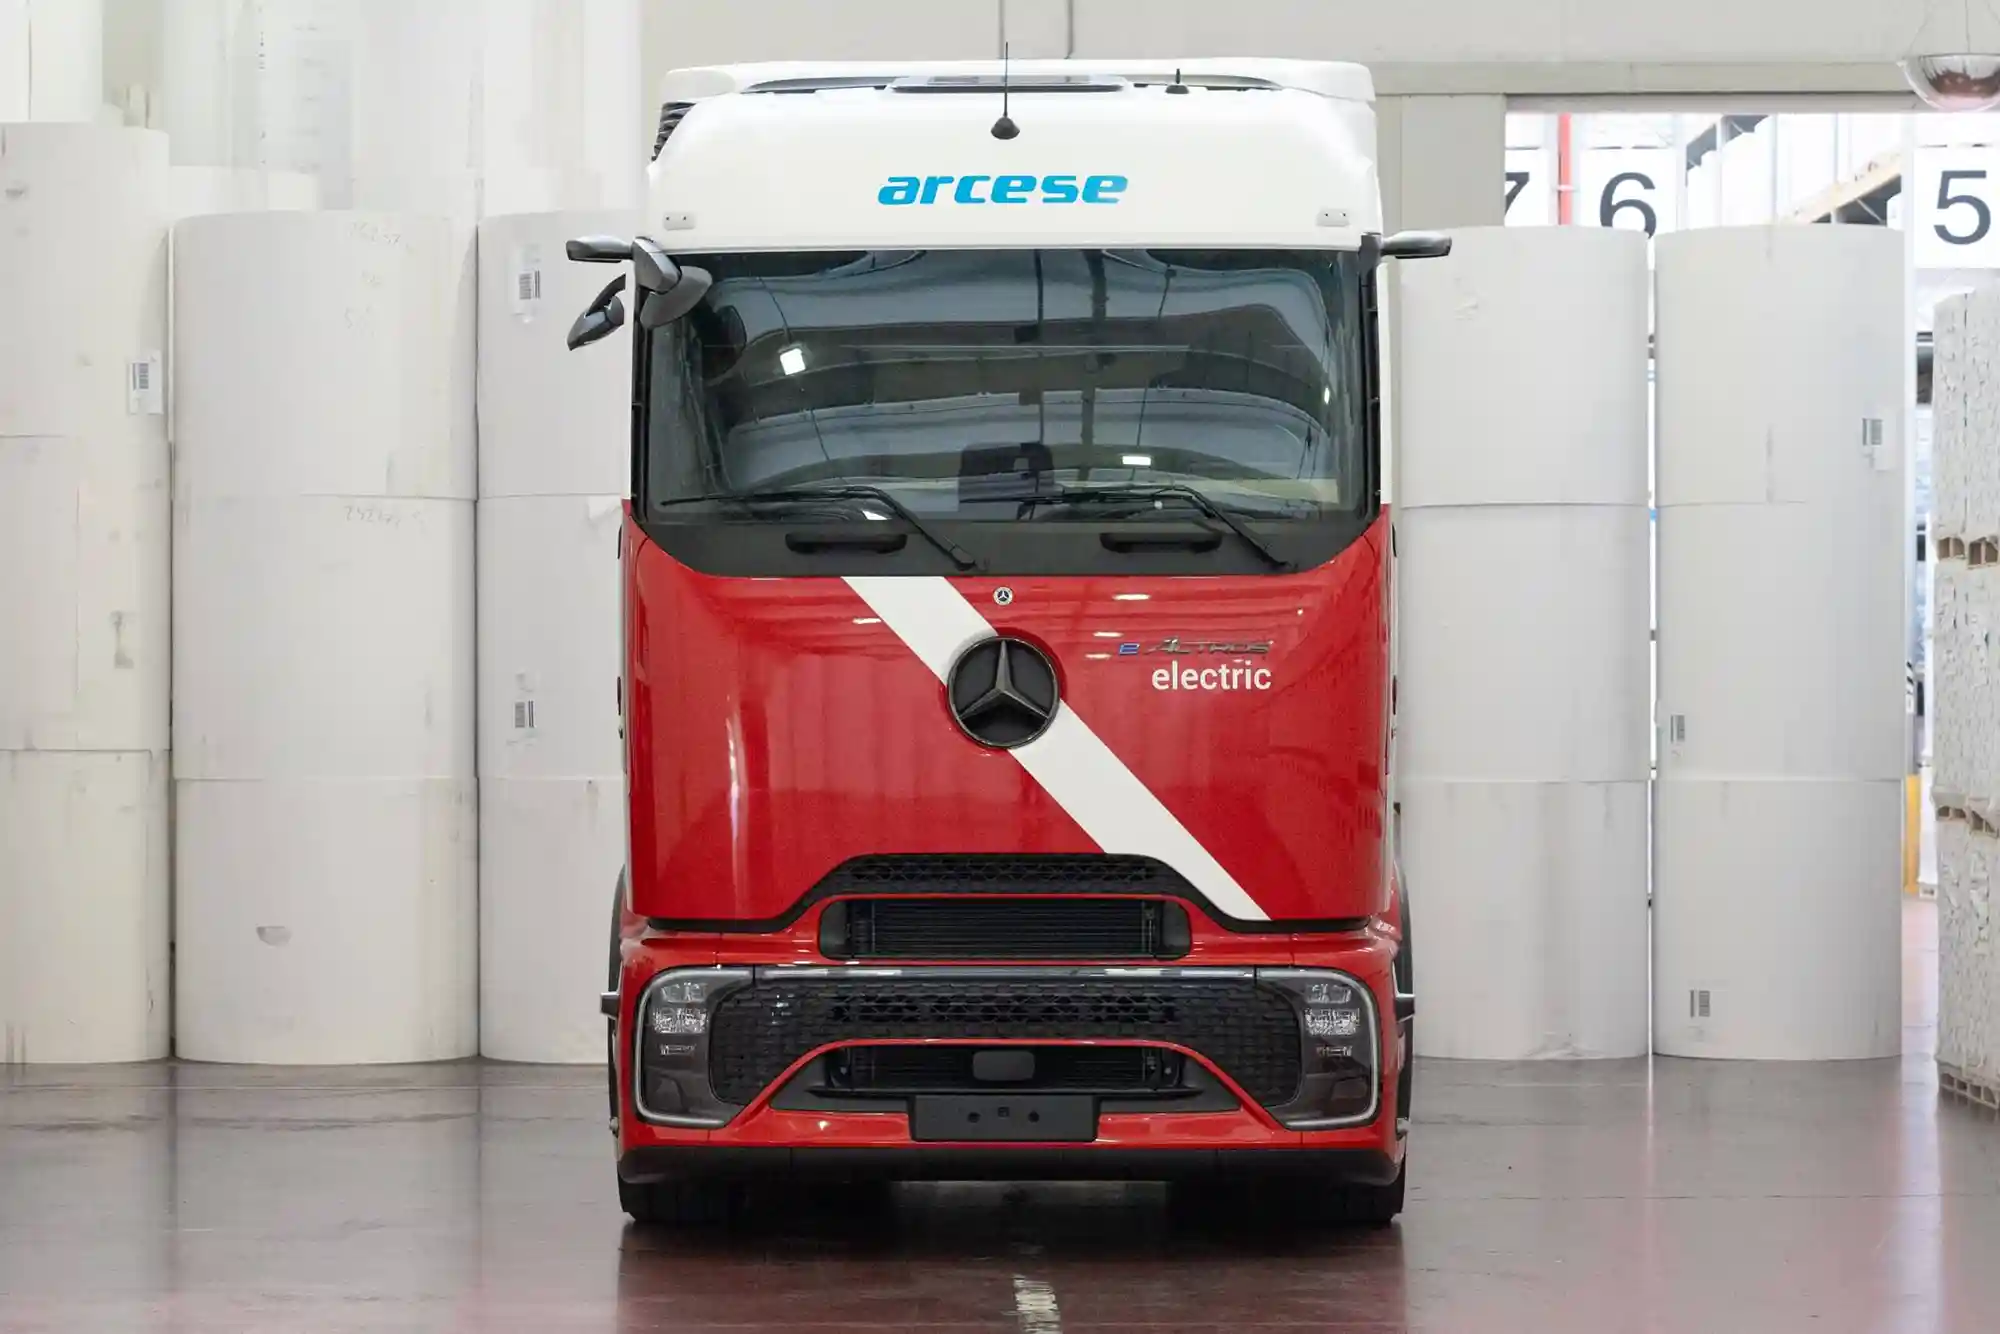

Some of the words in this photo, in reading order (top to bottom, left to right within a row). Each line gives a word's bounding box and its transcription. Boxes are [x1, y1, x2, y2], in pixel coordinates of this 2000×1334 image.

[877, 175, 1129, 205] arcese
[1599, 172, 1657, 239] 6
[1933, 170, 1991, 245] 5
[1151, 659, 1272, 690] electric
